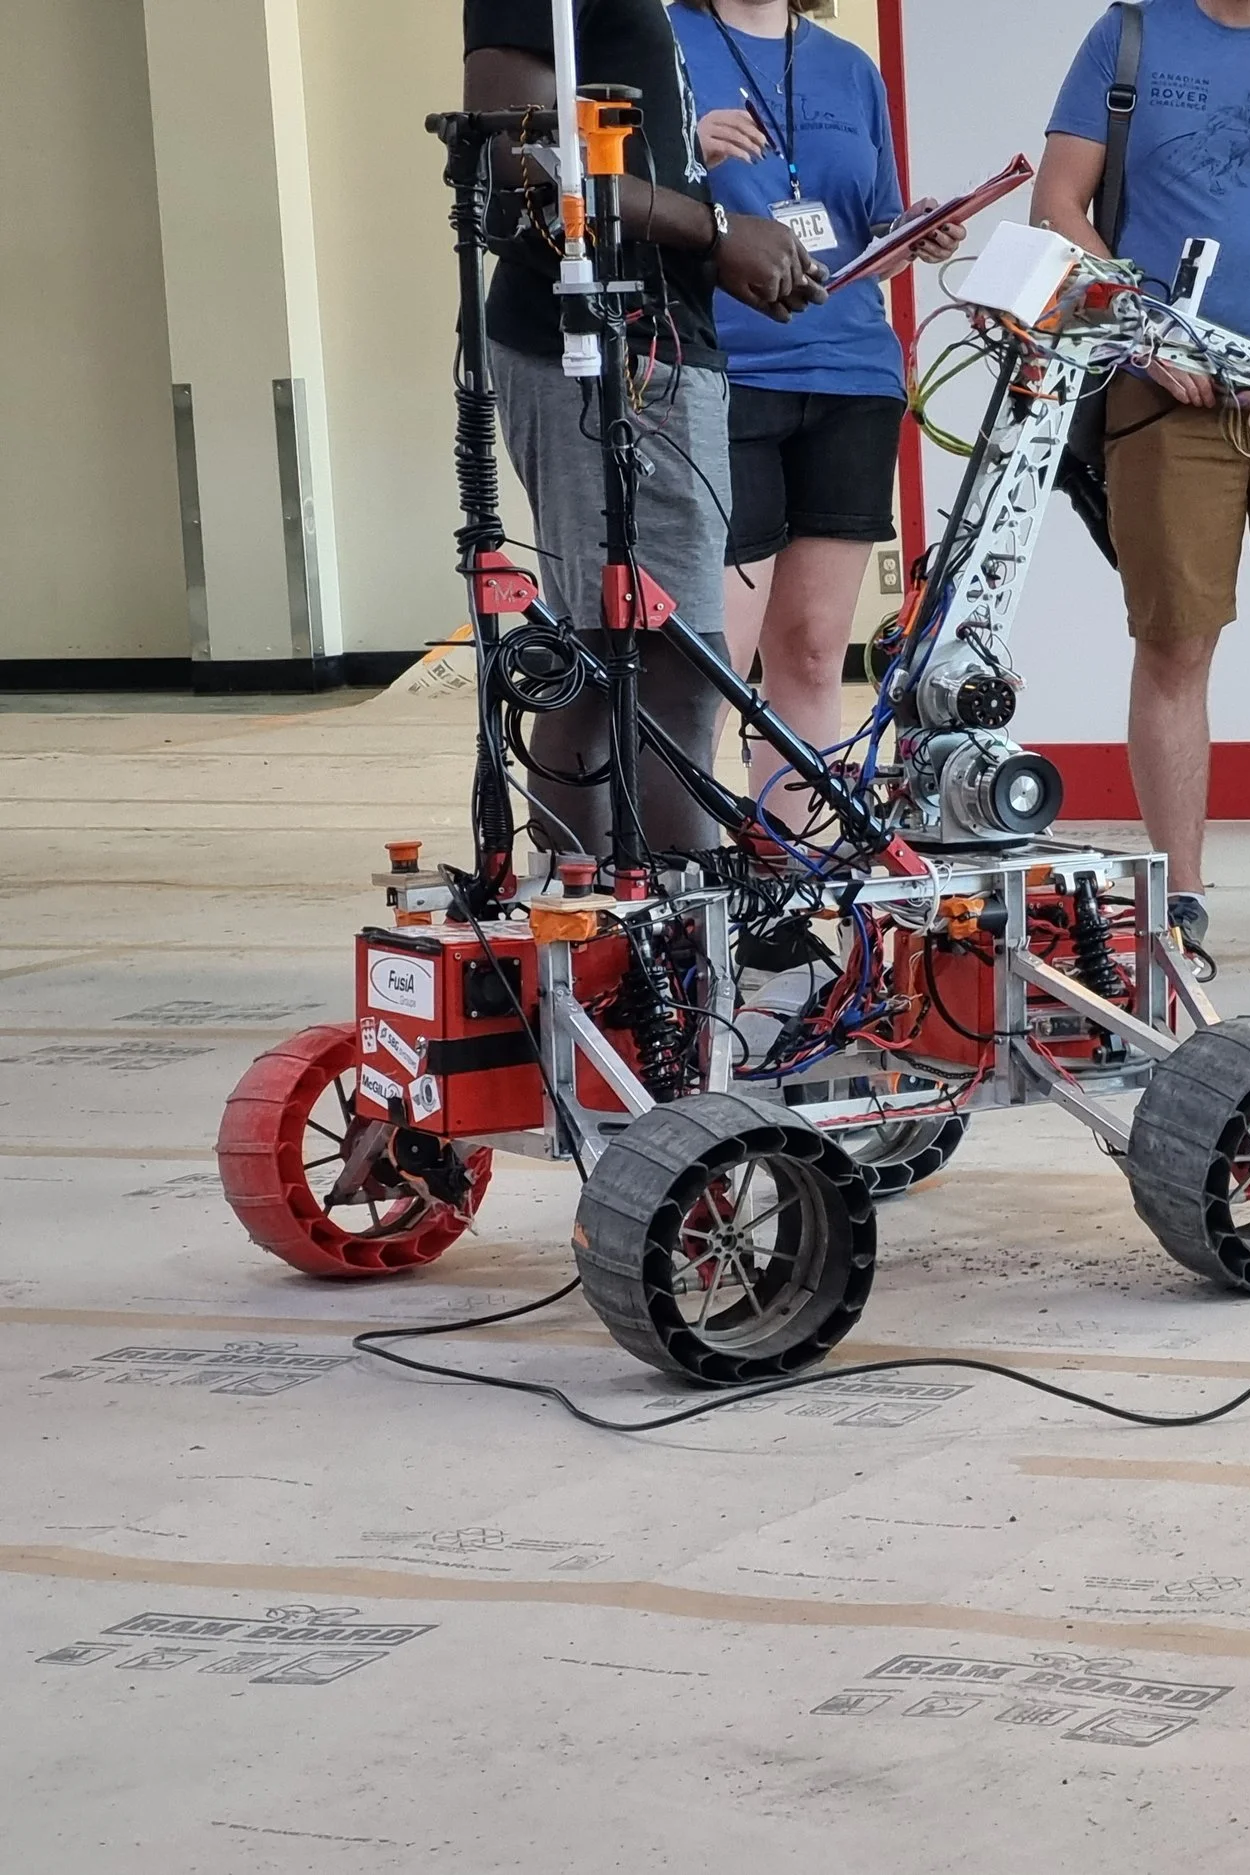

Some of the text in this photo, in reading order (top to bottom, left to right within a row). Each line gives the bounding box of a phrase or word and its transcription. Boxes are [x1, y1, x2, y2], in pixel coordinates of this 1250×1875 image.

[1151, 72, 1210, 85] CANADIAN
[1151, 87, 1208, 104] ROVER
[388, 970, 415, 994] FusiA
[126, 1617, 243, 1636] RAM
[244, 1625, 415, 1643] BOARD
[886, 1660, 1016, 1680] RAM
[1019, 1671, 1211, 1704] BOARD
